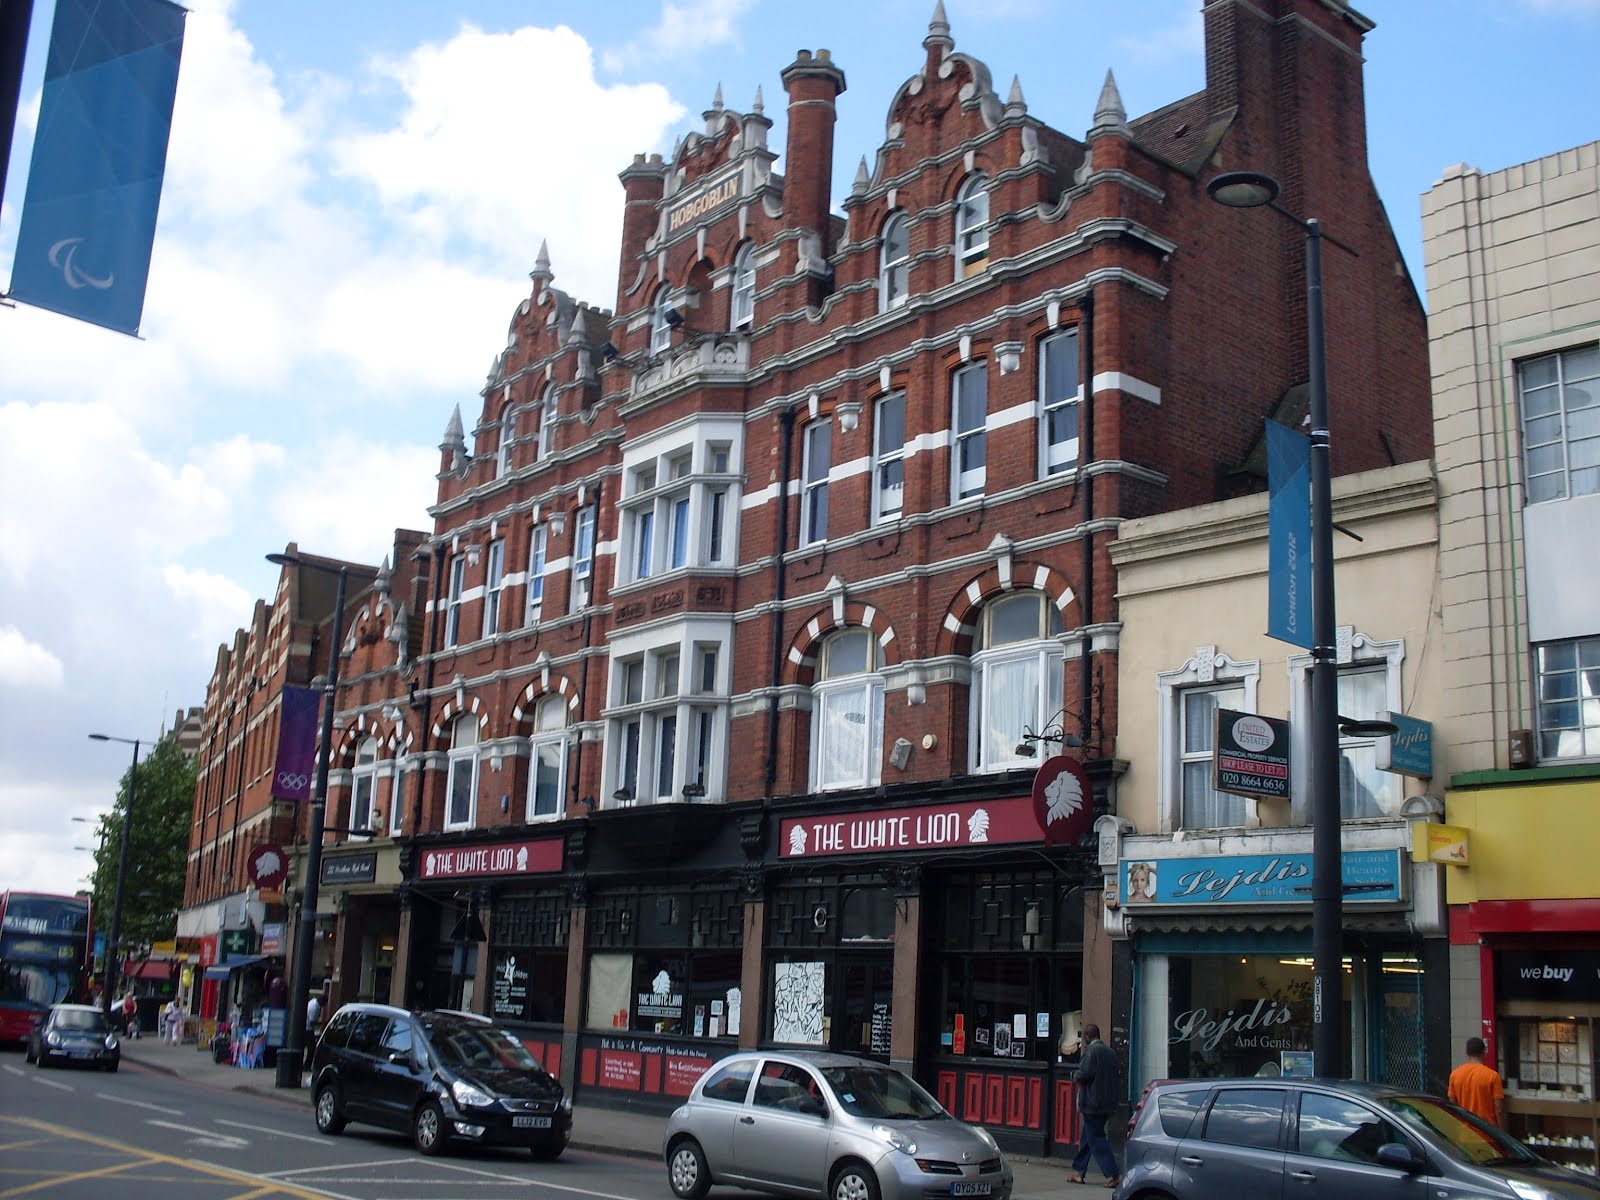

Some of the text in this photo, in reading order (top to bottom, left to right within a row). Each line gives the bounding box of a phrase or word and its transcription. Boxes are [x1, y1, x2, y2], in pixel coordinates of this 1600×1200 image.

[669, 176, 738, 232] HOBGOBLIN
[1286, 532, 1297, 634] London 2012
[1237, 722, 1266, 735] UNITED
[1240, 730, 1270, 747] ESTATES
[1220, 748, 1287, 764] COMMERCIAL PROPERTY SERVICES
[1222, 758, 1237, 769] SHOP
[1237, 761, 1255, 771] LEASE
[1256, 763, 1265, 773] TO
[1265, 765, 1276, 775] LET
[1222, 772, 1239, 784] 020
[1241, 775, 1261, 787] 8664
[1263, 778, 1285, 790] 6636
[813, 813, 960, 851] THE WHITE LION
[436, 848, 514, 874] THE WHITE LION
[1171, 858, 1309, 900] Lejdis
[1168, 998, 1292, 1050] Lejdis
[1234, 1035, 1291, 1048] And Gents
